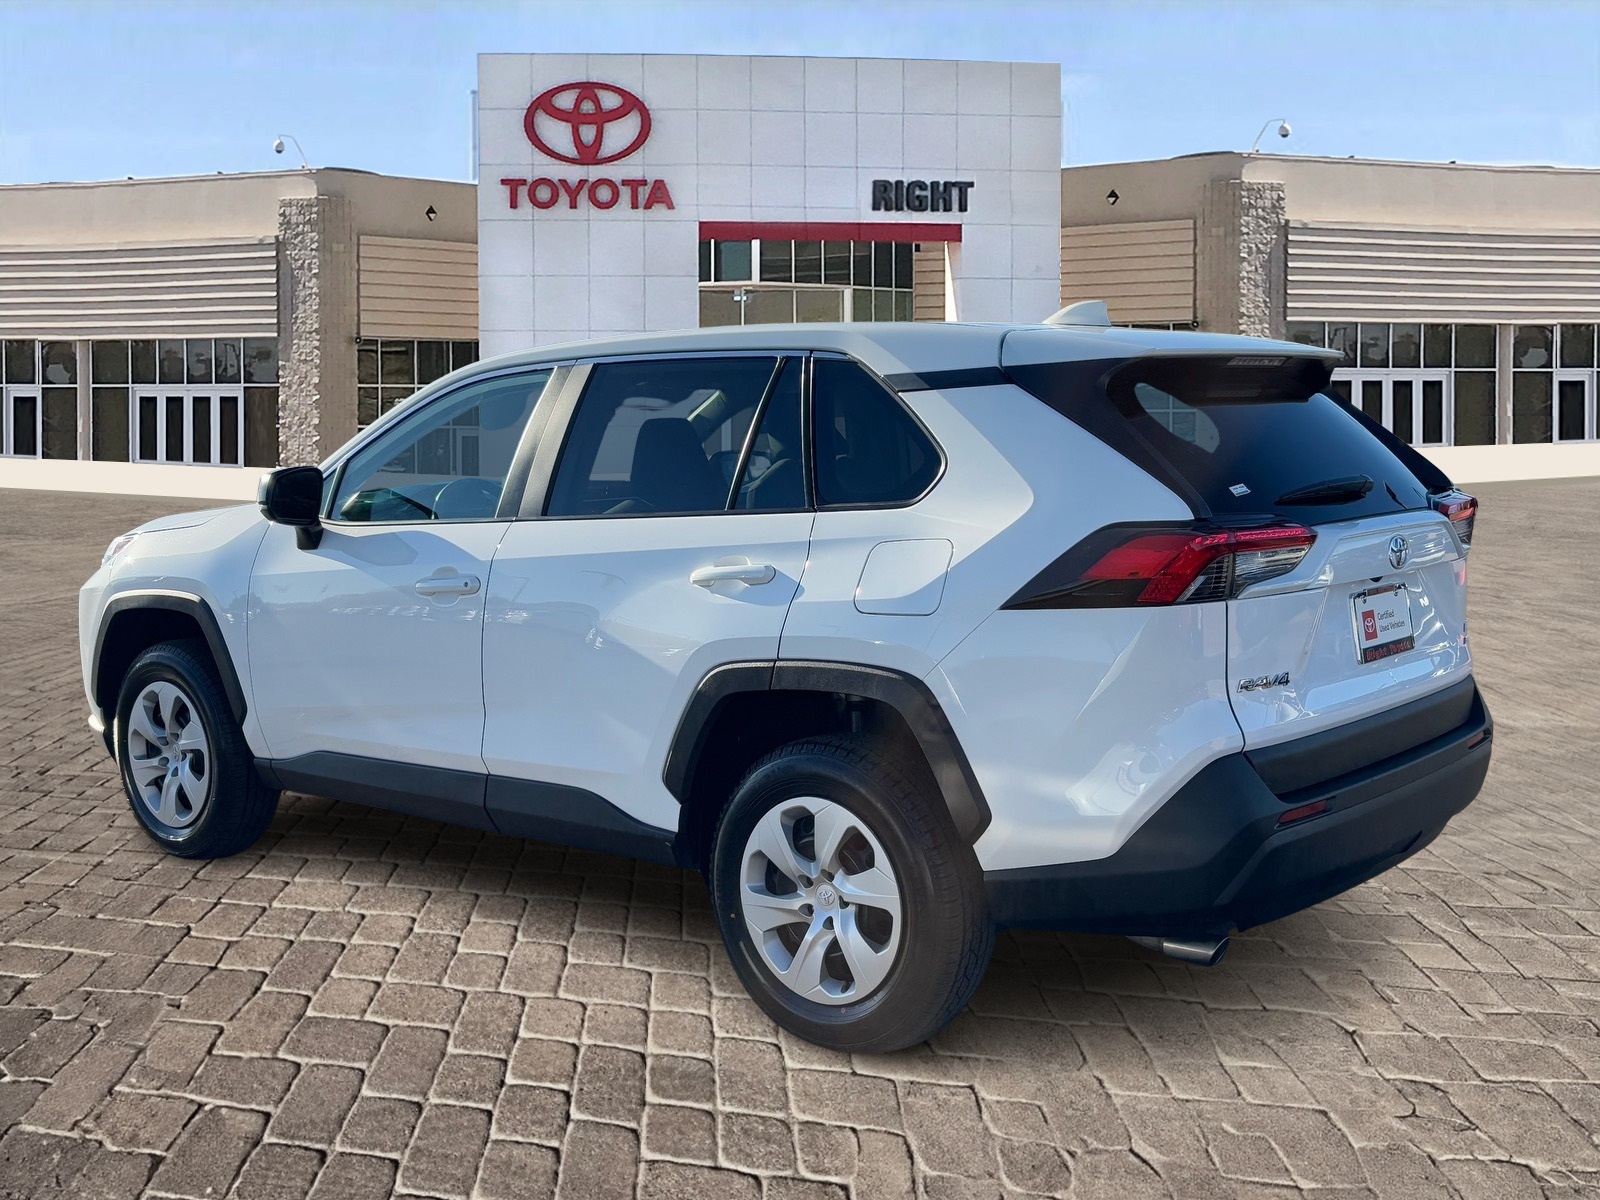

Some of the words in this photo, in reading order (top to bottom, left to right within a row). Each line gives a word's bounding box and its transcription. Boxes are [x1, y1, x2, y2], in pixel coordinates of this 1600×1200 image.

[500, 178, 675, 209] TOYOTA
[872, 180, 975, 212] RIGHT
[1377, 609, 1394, 620] Certified
[1379, 623, 1389, 632] Used
[1389, 620, 1405, 629] Vehicles
[1237, 672, 1290, 693] RAV4
